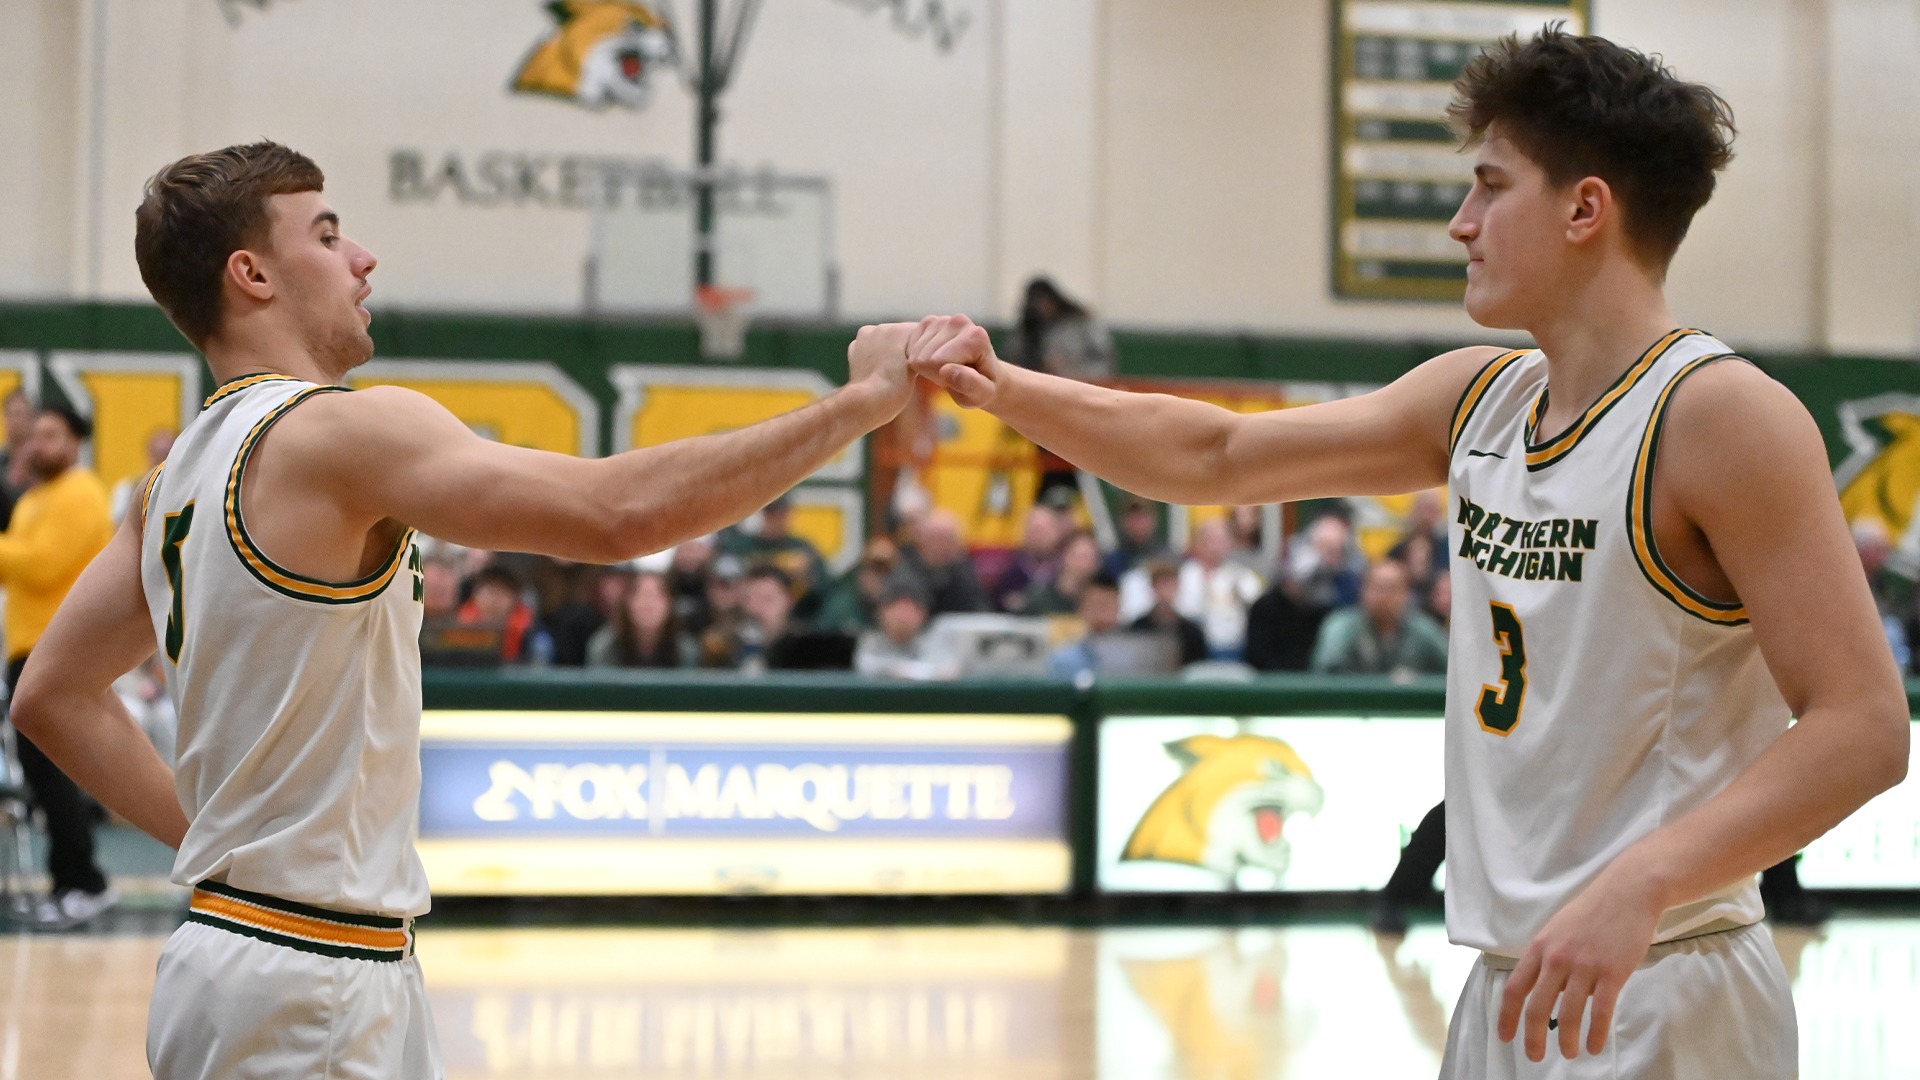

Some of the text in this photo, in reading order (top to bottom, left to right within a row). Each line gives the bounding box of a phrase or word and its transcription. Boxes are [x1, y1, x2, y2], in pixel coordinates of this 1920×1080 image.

[1457, 495, 1599, 550] NORTHERN
[1458, 529, 1584, 582] MCHIGAN
[1473, 599, 1529, 737] 3
[664, 763, 1017, 832] MARQUETTE
